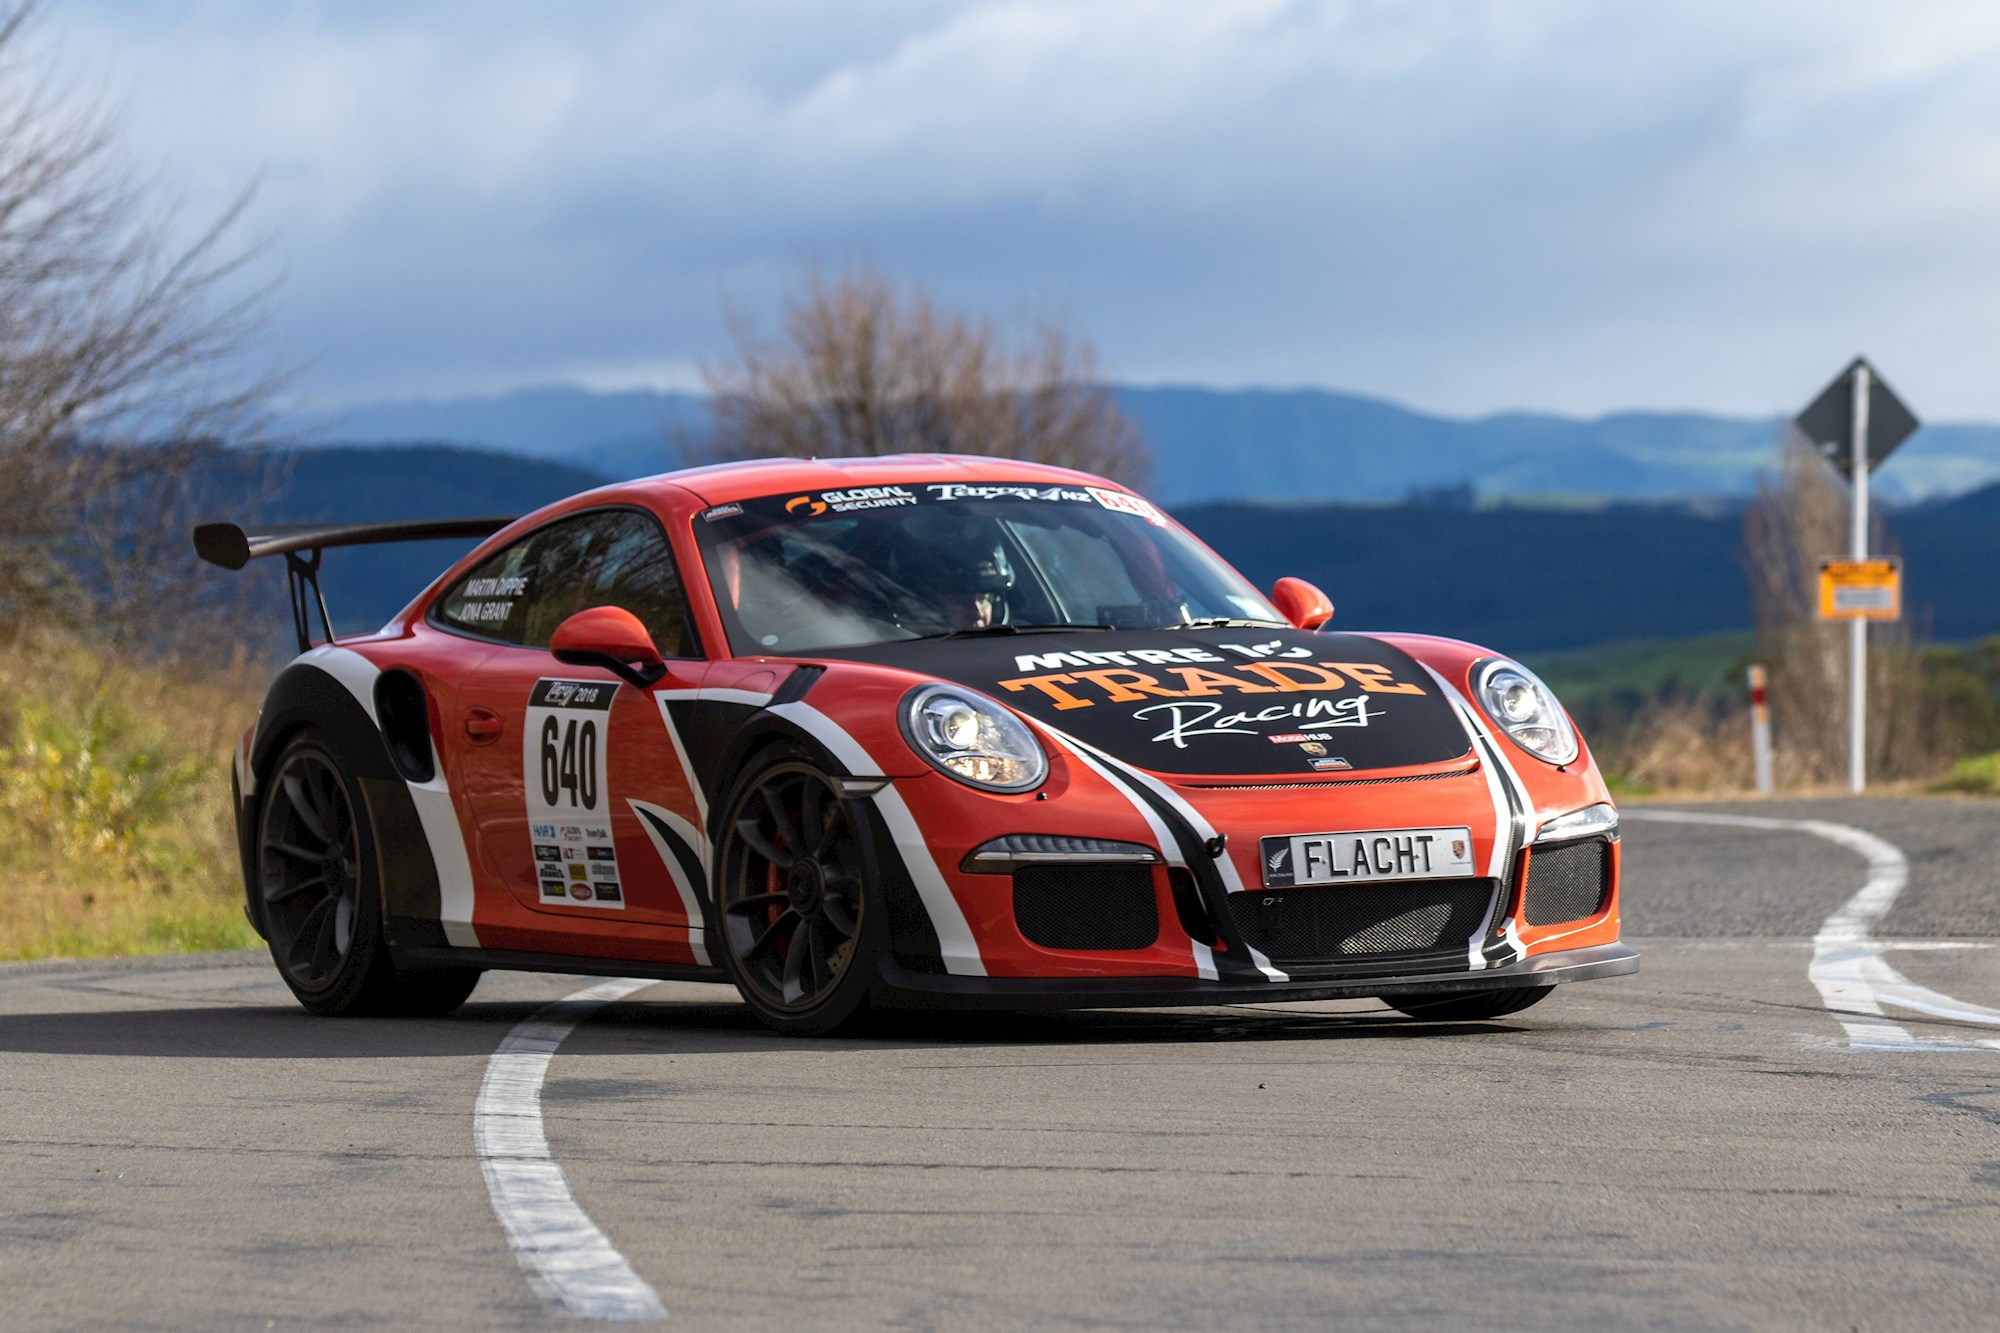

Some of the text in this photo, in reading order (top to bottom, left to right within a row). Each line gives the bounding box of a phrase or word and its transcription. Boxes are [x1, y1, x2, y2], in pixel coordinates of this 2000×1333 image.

[820, 486, 913, 504] GLOBAL
[926, 484, 1092, 503] Targa NZ
[831, 496, 917, 512] SECURITY
[463, 577, 528, 597] MARTIN DIPPIE
[458, 602, 513, 621] JONA GRANT
[1014, 647, 1226, 672] MITRE
[574, 687, 599, 703] 2018
[997, 661, 1427, 711] TRADE
[1132, 694, 1386, 749] Racing
[1268, 733, 1333, 744] MotoHUB
[541, 714, 597, 811] 640
[1303, 835, 1434, 878] FLACHT
